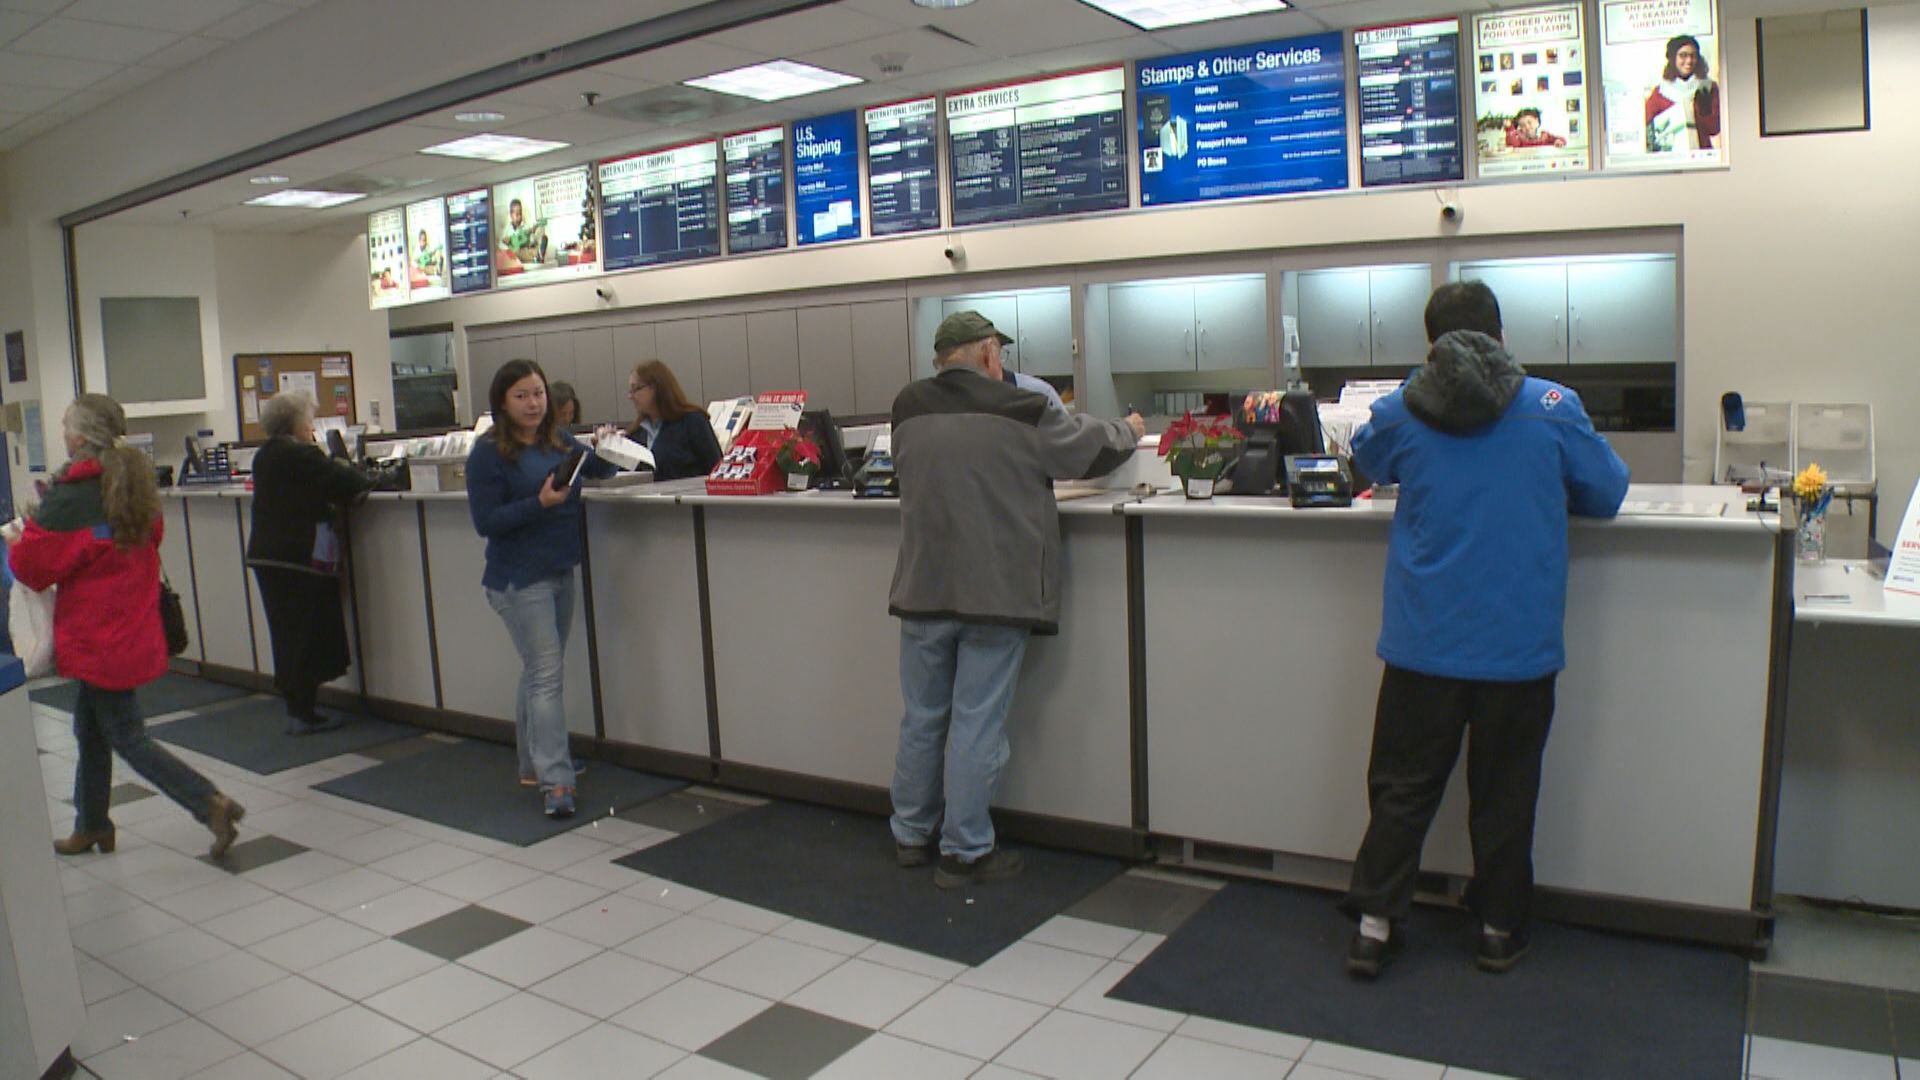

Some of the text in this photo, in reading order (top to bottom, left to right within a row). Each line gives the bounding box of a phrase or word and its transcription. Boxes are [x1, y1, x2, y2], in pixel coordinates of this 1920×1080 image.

[1625, 2, 1654, 12] SNEAK
[1485, 14, 1570, 31] ADD CHEER WITH
[1629, 12, 1638, 20] AT
[1633, 18, 1684, 28] GREETINGS
[1376, 27, 1412, 40] SHIPPING
[1484, 24, 1572, 40] FOREVER STAMPS
[1142, 47, 1321, 86] Stamps & Other Services
[1194, 84, 1219, 96] Stamps
[948, 89, 1020, 113] EXTRA SERVICES
[1195, 101, 1239, 113] Money Orders
[867, 106, 907, 120] INTERNATIONAL
[909, 101, 934, 114] SHIPPING
[1196, 120, 1228, 132] Passports
[796, 125, 815, 142] U.S.
[796, 139, 841, 159] Shipping
[1197, 136, 1247, 150] Passport Photos
[600, 153, 675, 178] INTERNATIONAL SHIPPING
[1197, 157, 1206, 168] PO
